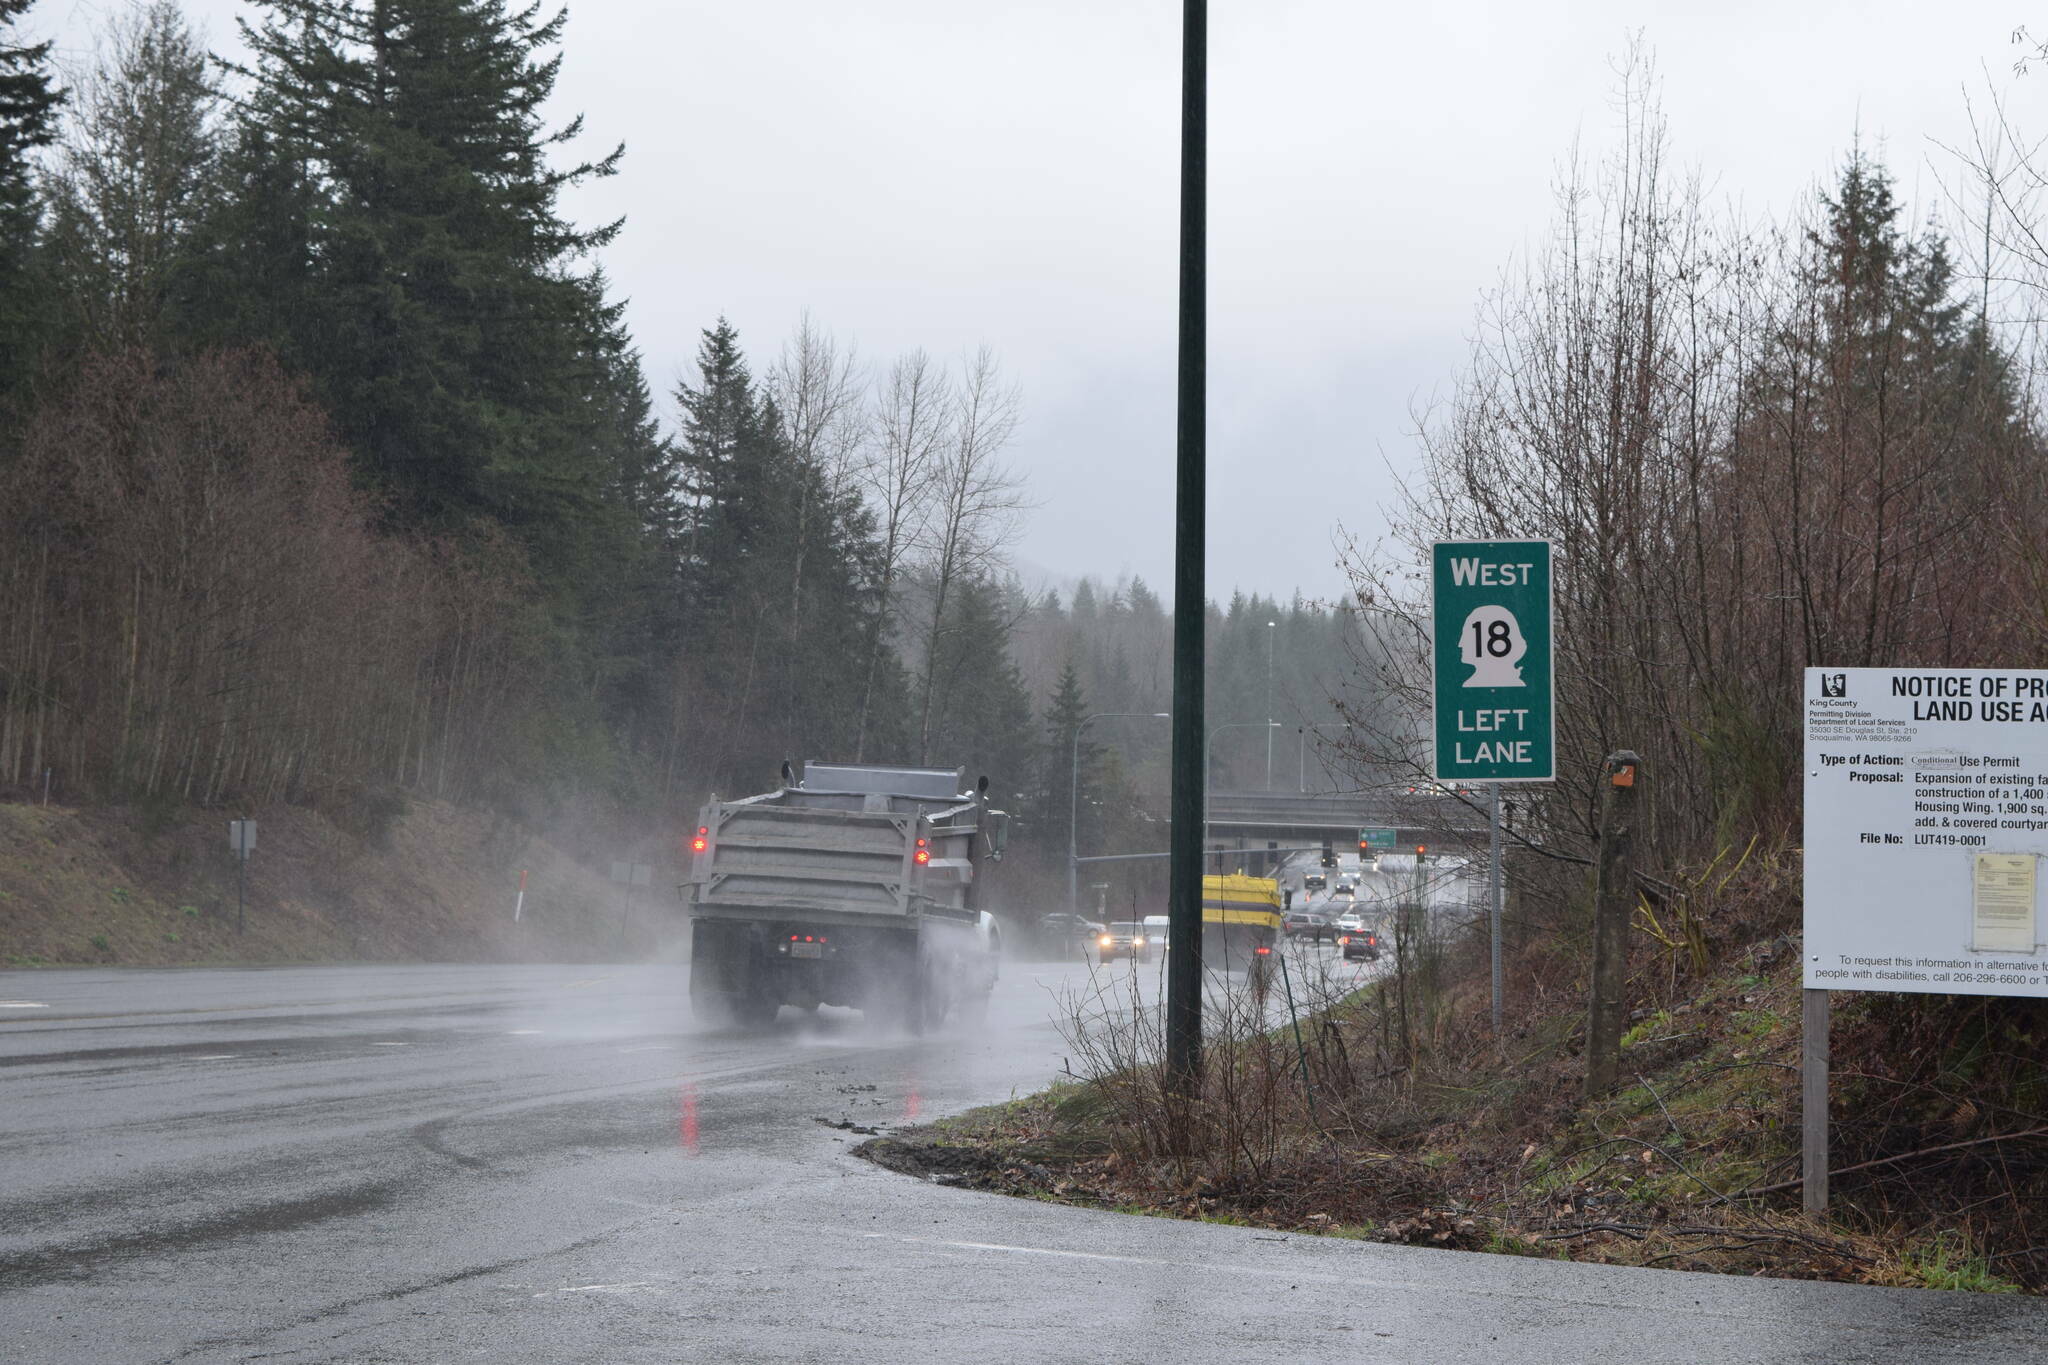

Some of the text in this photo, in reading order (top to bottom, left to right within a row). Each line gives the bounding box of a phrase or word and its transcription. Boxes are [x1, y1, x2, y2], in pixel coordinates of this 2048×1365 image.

[1450, 558, 1533, 586] WEST
[1472, 620, 1512, 658] 18
[1892, 676, 2048, 698] NOTICE OF PR
[1810, 700, 1857, 708] King County
[1914, 701, 1972, 721] LAND
[1981, 702, 2023, 722] USE
[1458, 710, 1528, 732] LEFT
[1456, 742, 1532, 764] LANE
[1820, 754, 2020, 767] Type of Action: Conditional Use Permit
[1850, 771, 1903, 784] Proposal:
[1915, 773, 1972, 785] Expansion
[1975, 773, 1987, 784] of
[1990, 774, 2034, 787] existing
[1915, 788, 1985, 798] construction
[1989, 788, 2000, 798] of
[2003, 790, 2009, 798] a
[2013, 789, 2044, 800] 1,400
[1915, 801, 2048, 816] Housing Wing. 1,900 sq.
[1915, 816, 1939, 827] add.
[1942, 817, 1950, 827] &
[1953, 818, 1997, 828] covered
[1860, 833, 1986, 846] File No: LUT419-0001
[1840, 955, 1850, 964] To
[1854, 956, 1892, 966] request
[1895, 957, 1912, 966] this
[1916, 958, 1971, 968] information
[1975, 960, 1983, 969] in
[1987, 960, 2038, 970] alternative
[1816, 968, 1849, 978] people
[1853, 970, 1872, 979] with
[1876, 971, 1930, 982] disabilities,
[1933, 973, 1950, 982] call
[1953, 973, 2026, 984] 206-296-6600
